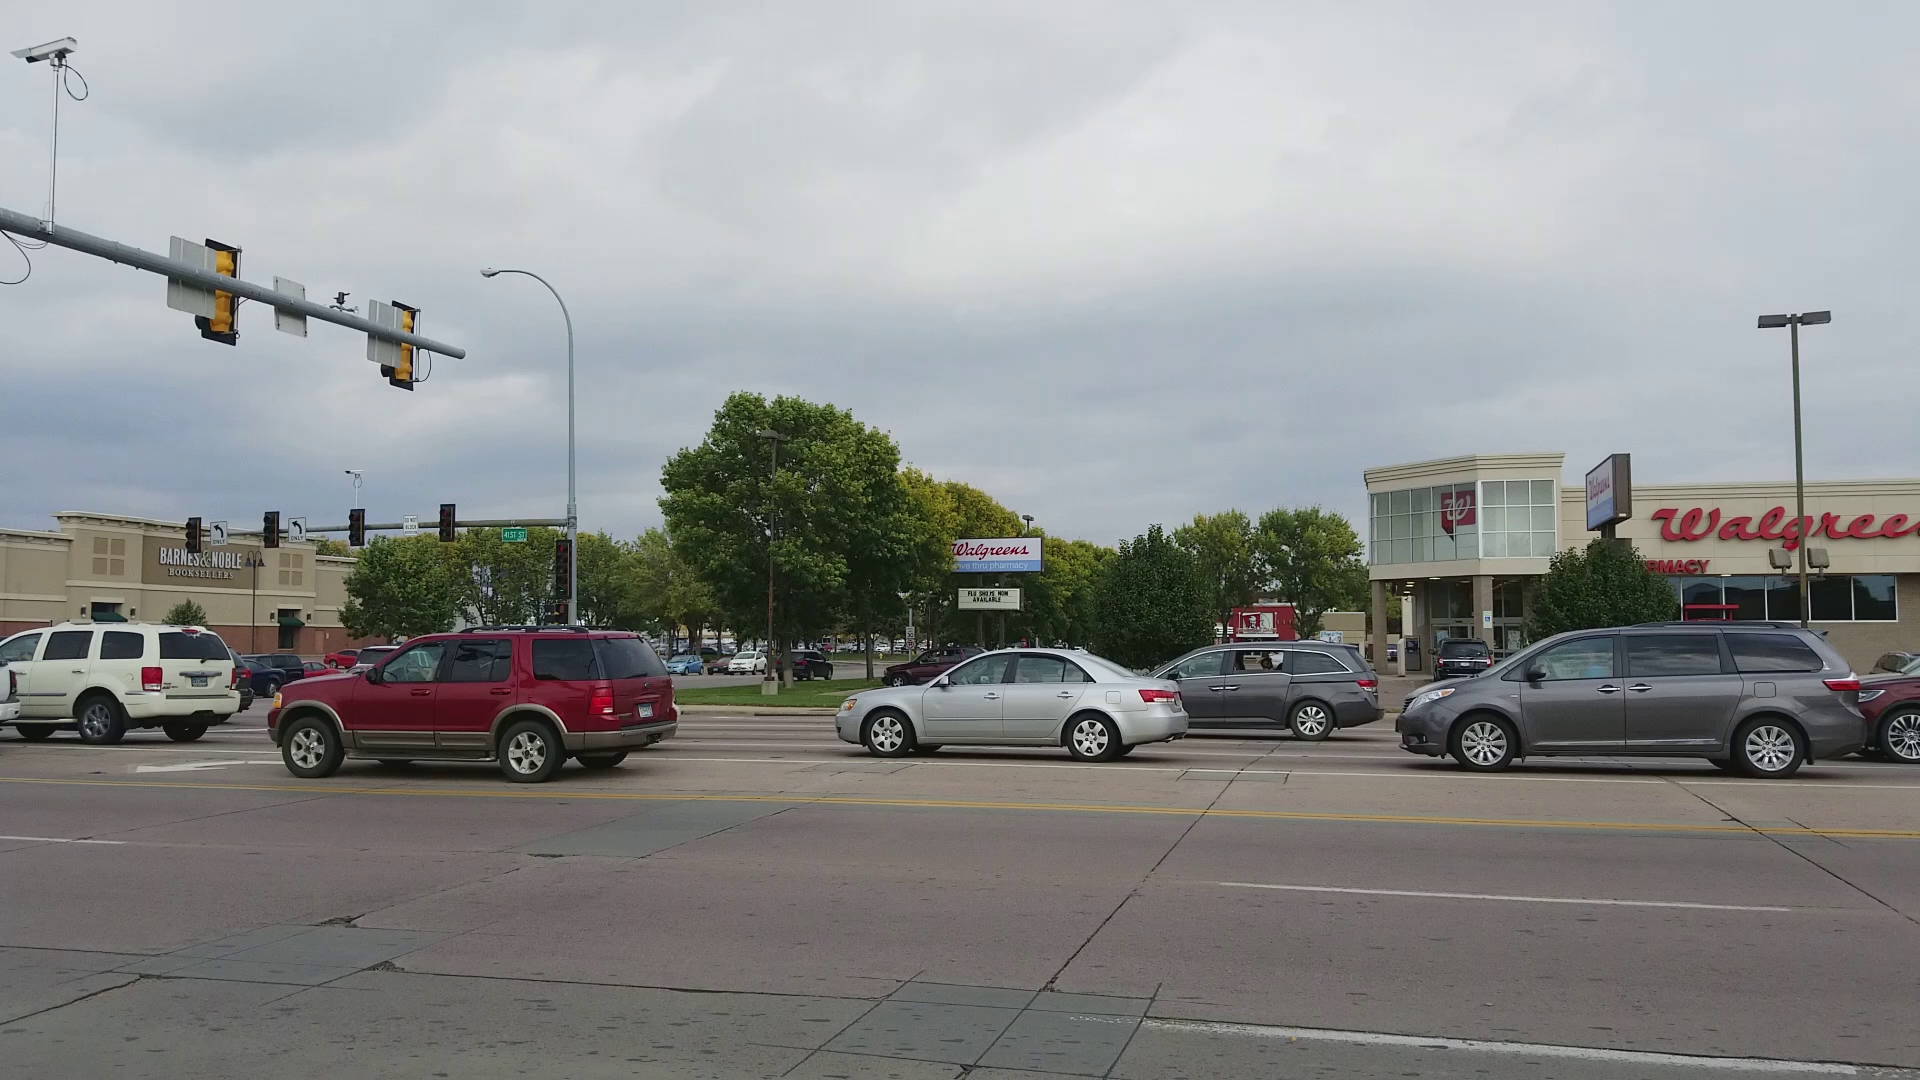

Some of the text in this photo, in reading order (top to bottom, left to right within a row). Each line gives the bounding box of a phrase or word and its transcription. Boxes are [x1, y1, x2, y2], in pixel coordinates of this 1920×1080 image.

[1652, 506, 1920, 551] Walgree
[952, 541, 1029, 560] Walgreens
[168, 568, 234, 580] BOOKSELLERS
[972, 562, 987, 570] thru
[989, 562, 1028, 571] pharmacy
